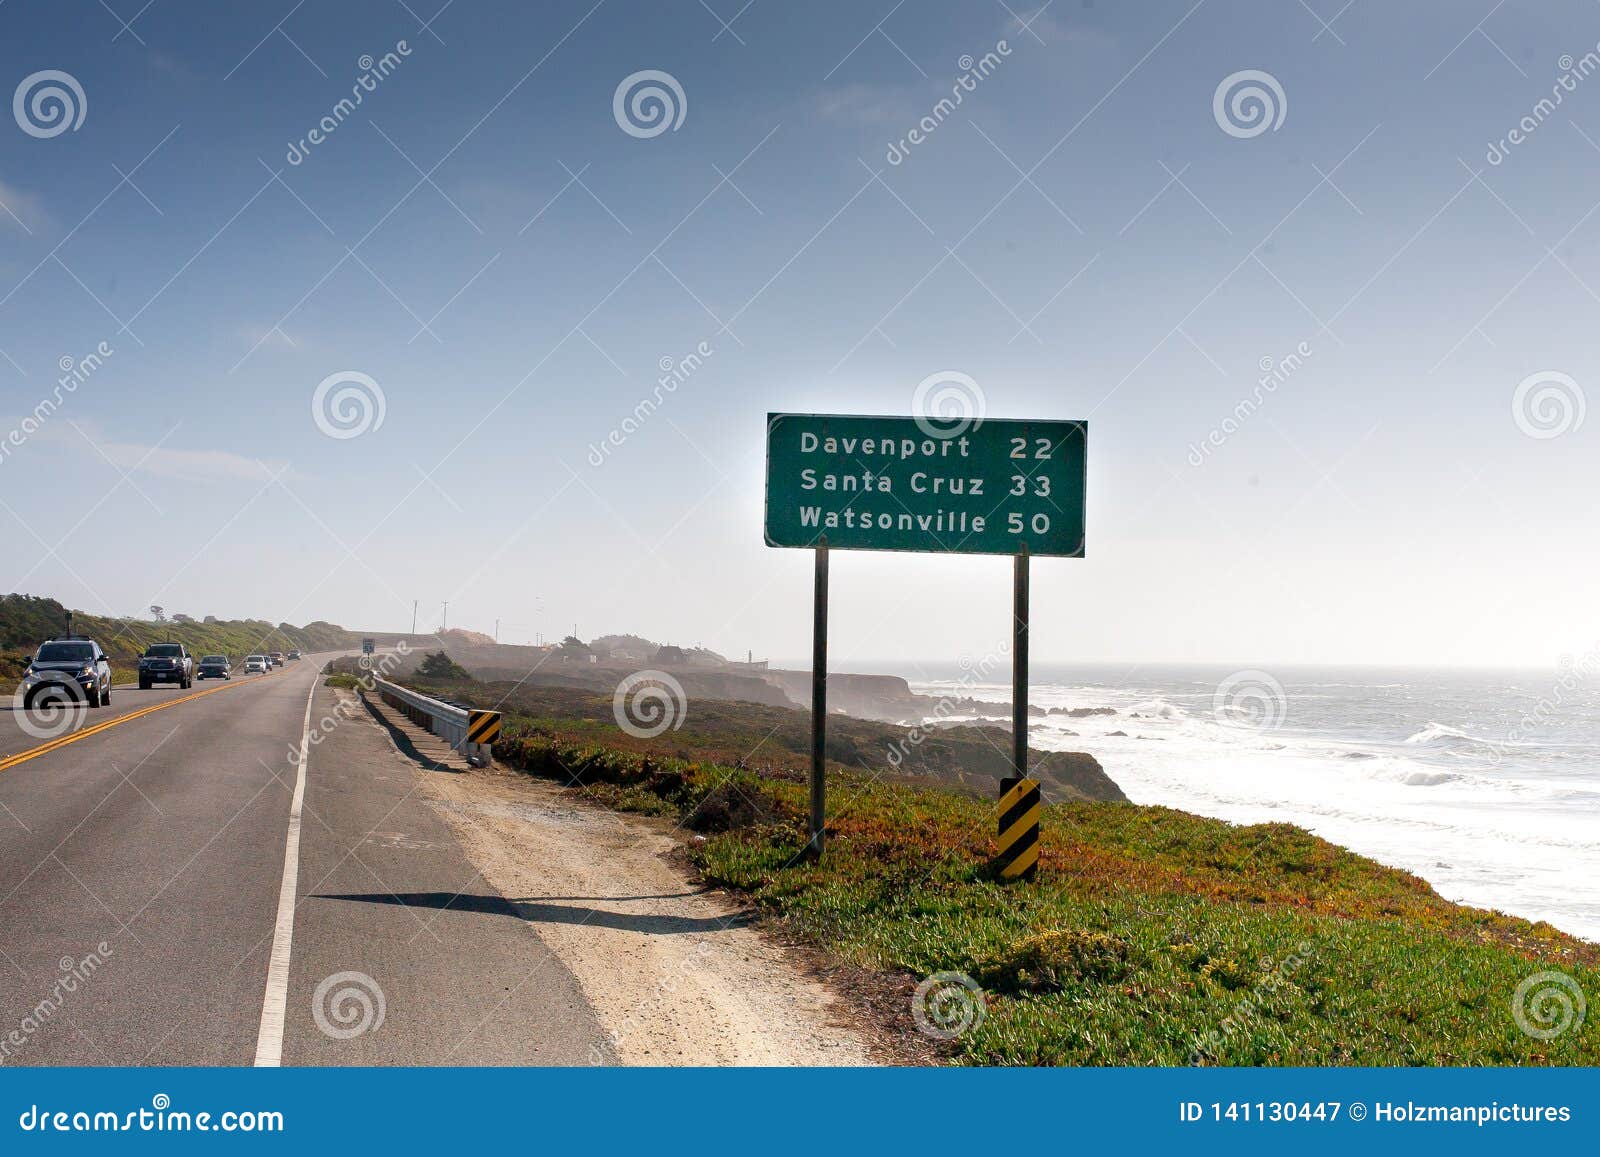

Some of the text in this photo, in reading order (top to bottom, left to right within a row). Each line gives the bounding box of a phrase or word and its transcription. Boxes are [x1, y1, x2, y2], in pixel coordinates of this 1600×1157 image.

[801, 432, 1052, 460] Davenport 22
[801, 469, 1051, 497] Santa Cruz 33
[799, 506, 1050, 534] Watsonville 50
